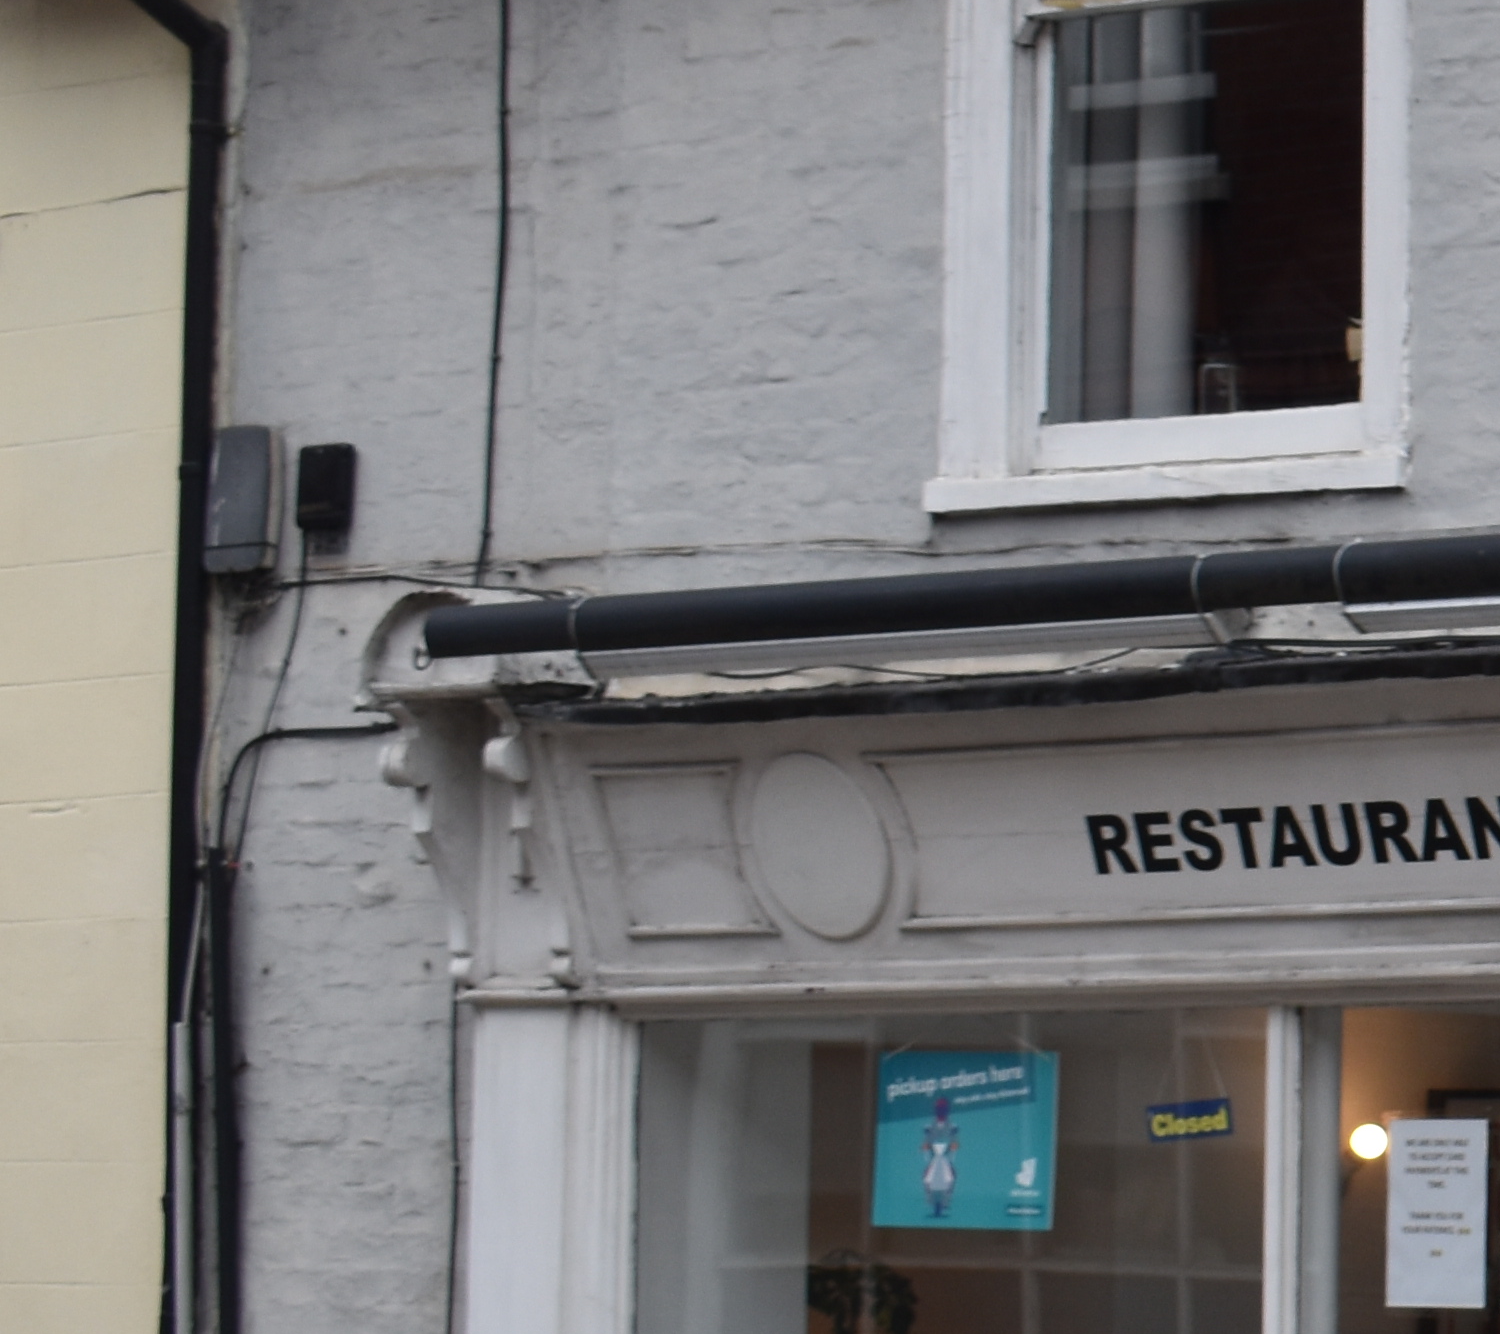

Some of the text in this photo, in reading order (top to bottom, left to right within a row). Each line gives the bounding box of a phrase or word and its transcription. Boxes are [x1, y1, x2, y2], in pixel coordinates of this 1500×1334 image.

[886, 1076, 937, 1103] pickup
[940, 1069, 987, 1090] orders
[989, 1064, 1024, 1083] here
[1151, 1106, 1229, 1139] Closed
